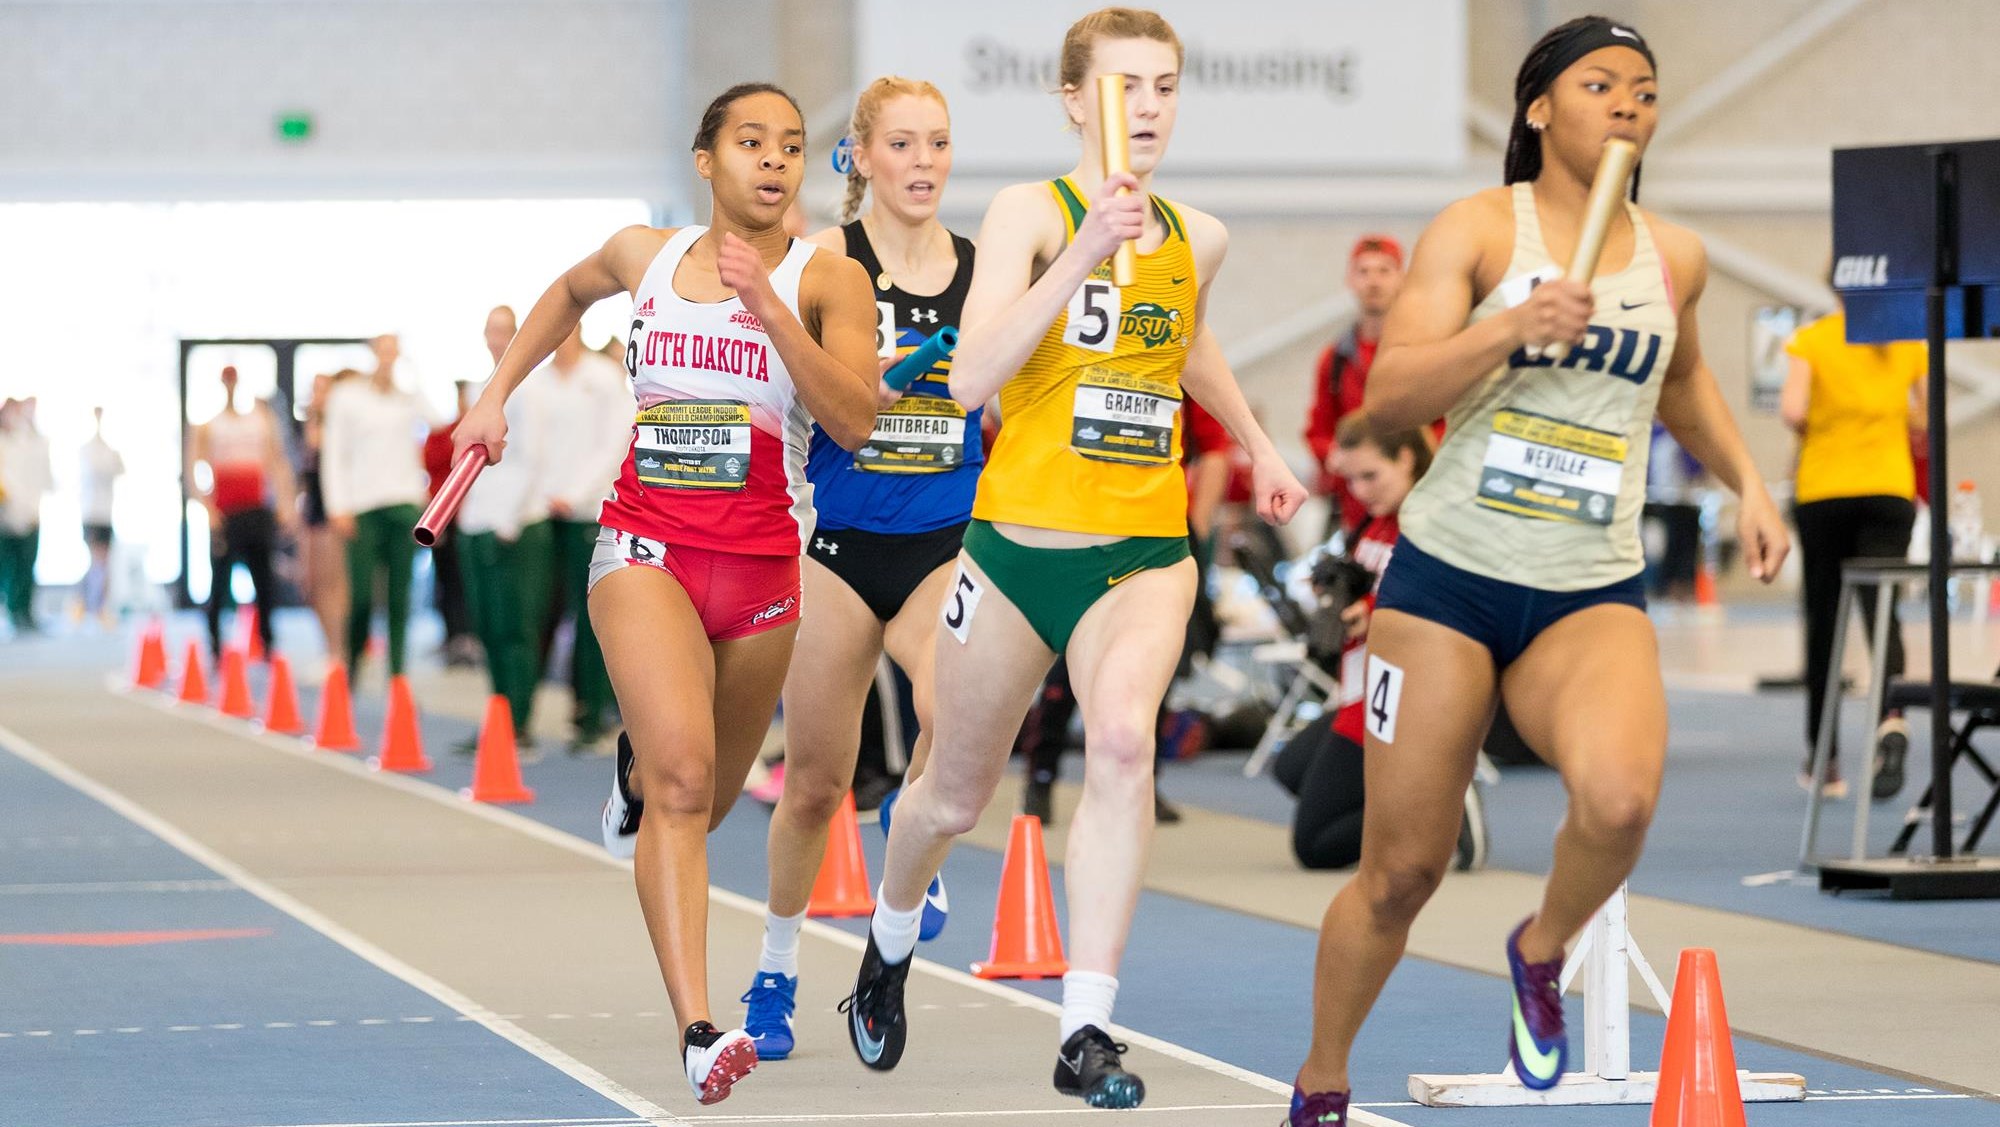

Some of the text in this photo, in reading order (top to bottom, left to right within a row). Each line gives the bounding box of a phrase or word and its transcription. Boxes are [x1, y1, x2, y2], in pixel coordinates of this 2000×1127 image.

[1833, 254, 1888, 288] GILL
[741, 324, 766, 334] LEAGU
[1078, 284, 1110, 346] 5
[626, 319, 644, 378] 6
[640, 330, 769, 382] UTH DAKOTA
[660, 414, 671, 422] AND
[672, 414, 690, 422] FIELD
[690, 414, 745, 422] CHAMPIONSHIPS
[662, 406, 688, 415] SUMMIT
[689, 406, 712, 415] LEAGUE
[713, 406, 738, 415] INDOOR
[654, 428, 732, 446] THOMPSON
[1523, 447, 1588, 477] NEVILLE
[945, 572, 975, 629] 5
[1371, 669, 1391, 733] 4
